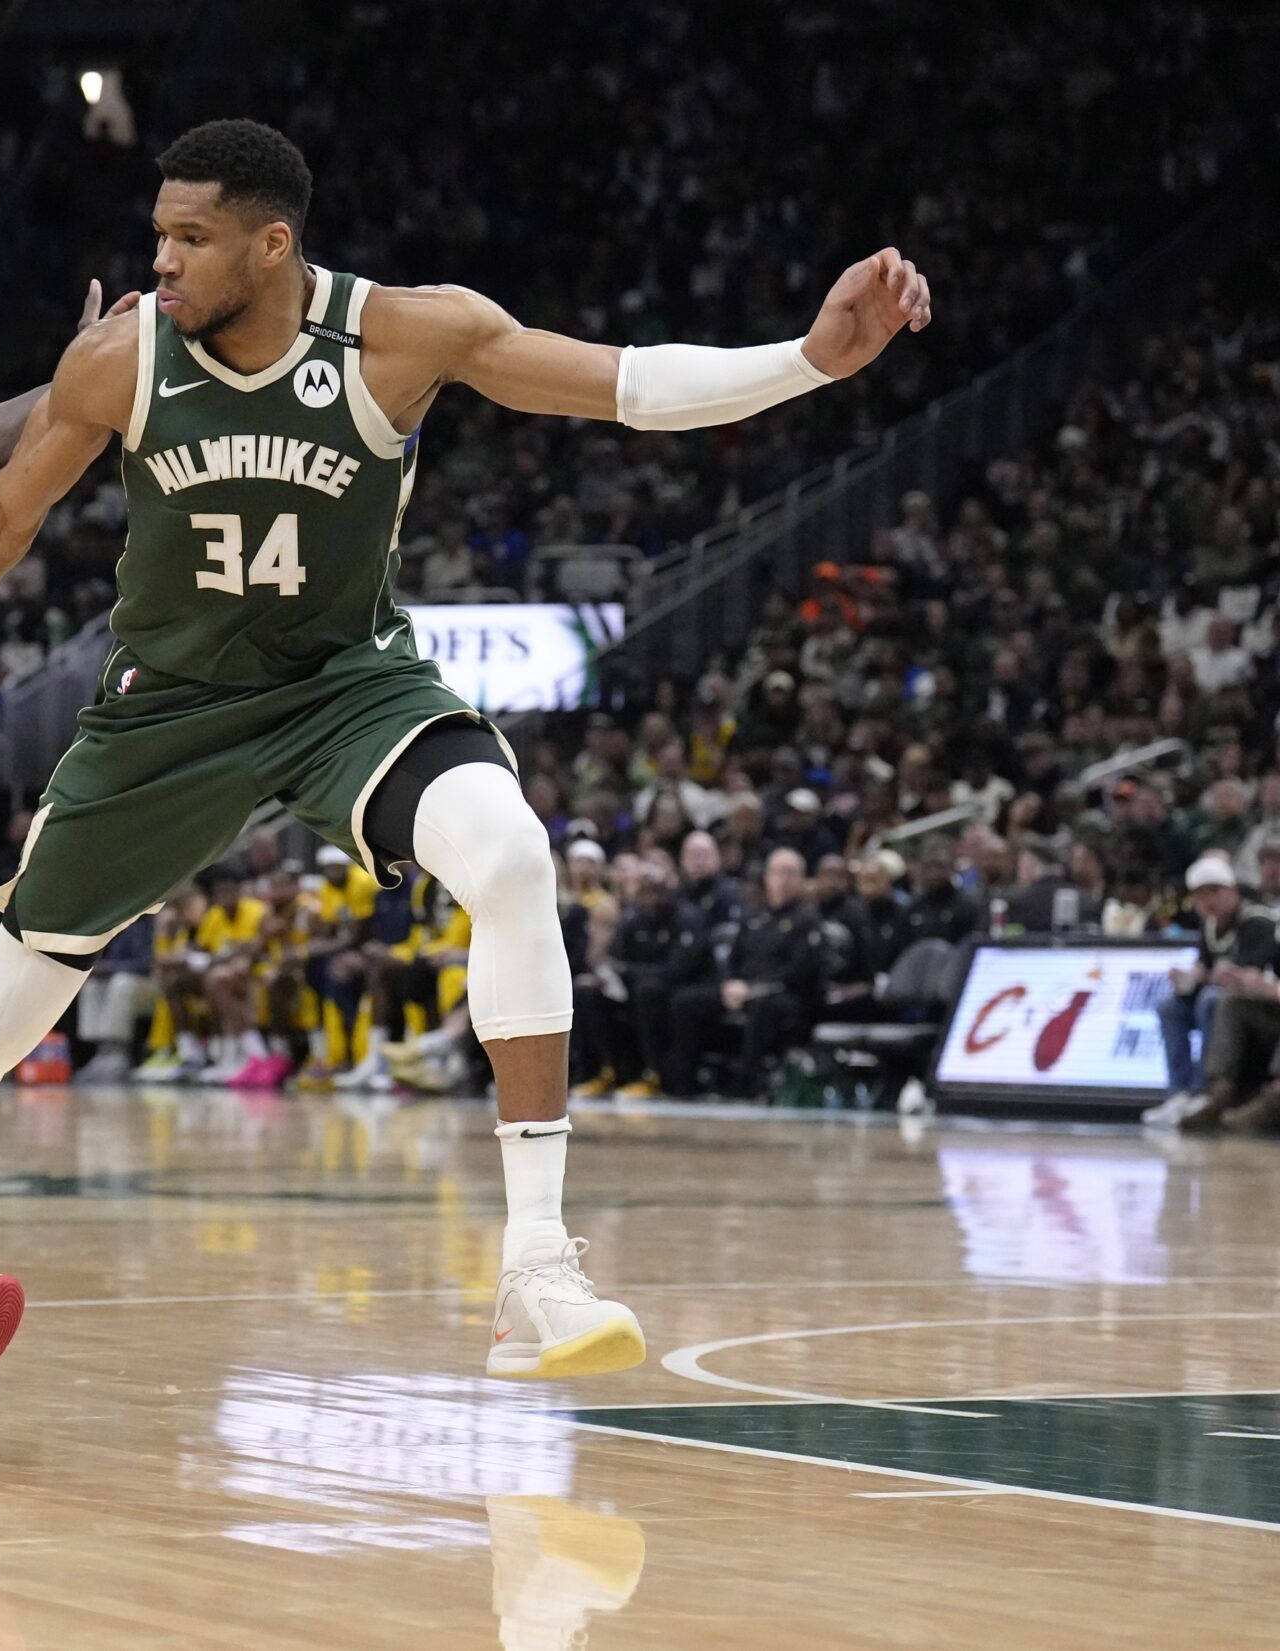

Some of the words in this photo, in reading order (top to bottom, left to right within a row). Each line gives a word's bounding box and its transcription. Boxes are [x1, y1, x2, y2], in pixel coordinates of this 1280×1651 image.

[308, 324, 356, 346] BRIDGEMAN
[144, 434, 362, 500] MILWAUKEE
[189, 512, 307, 597] 34
